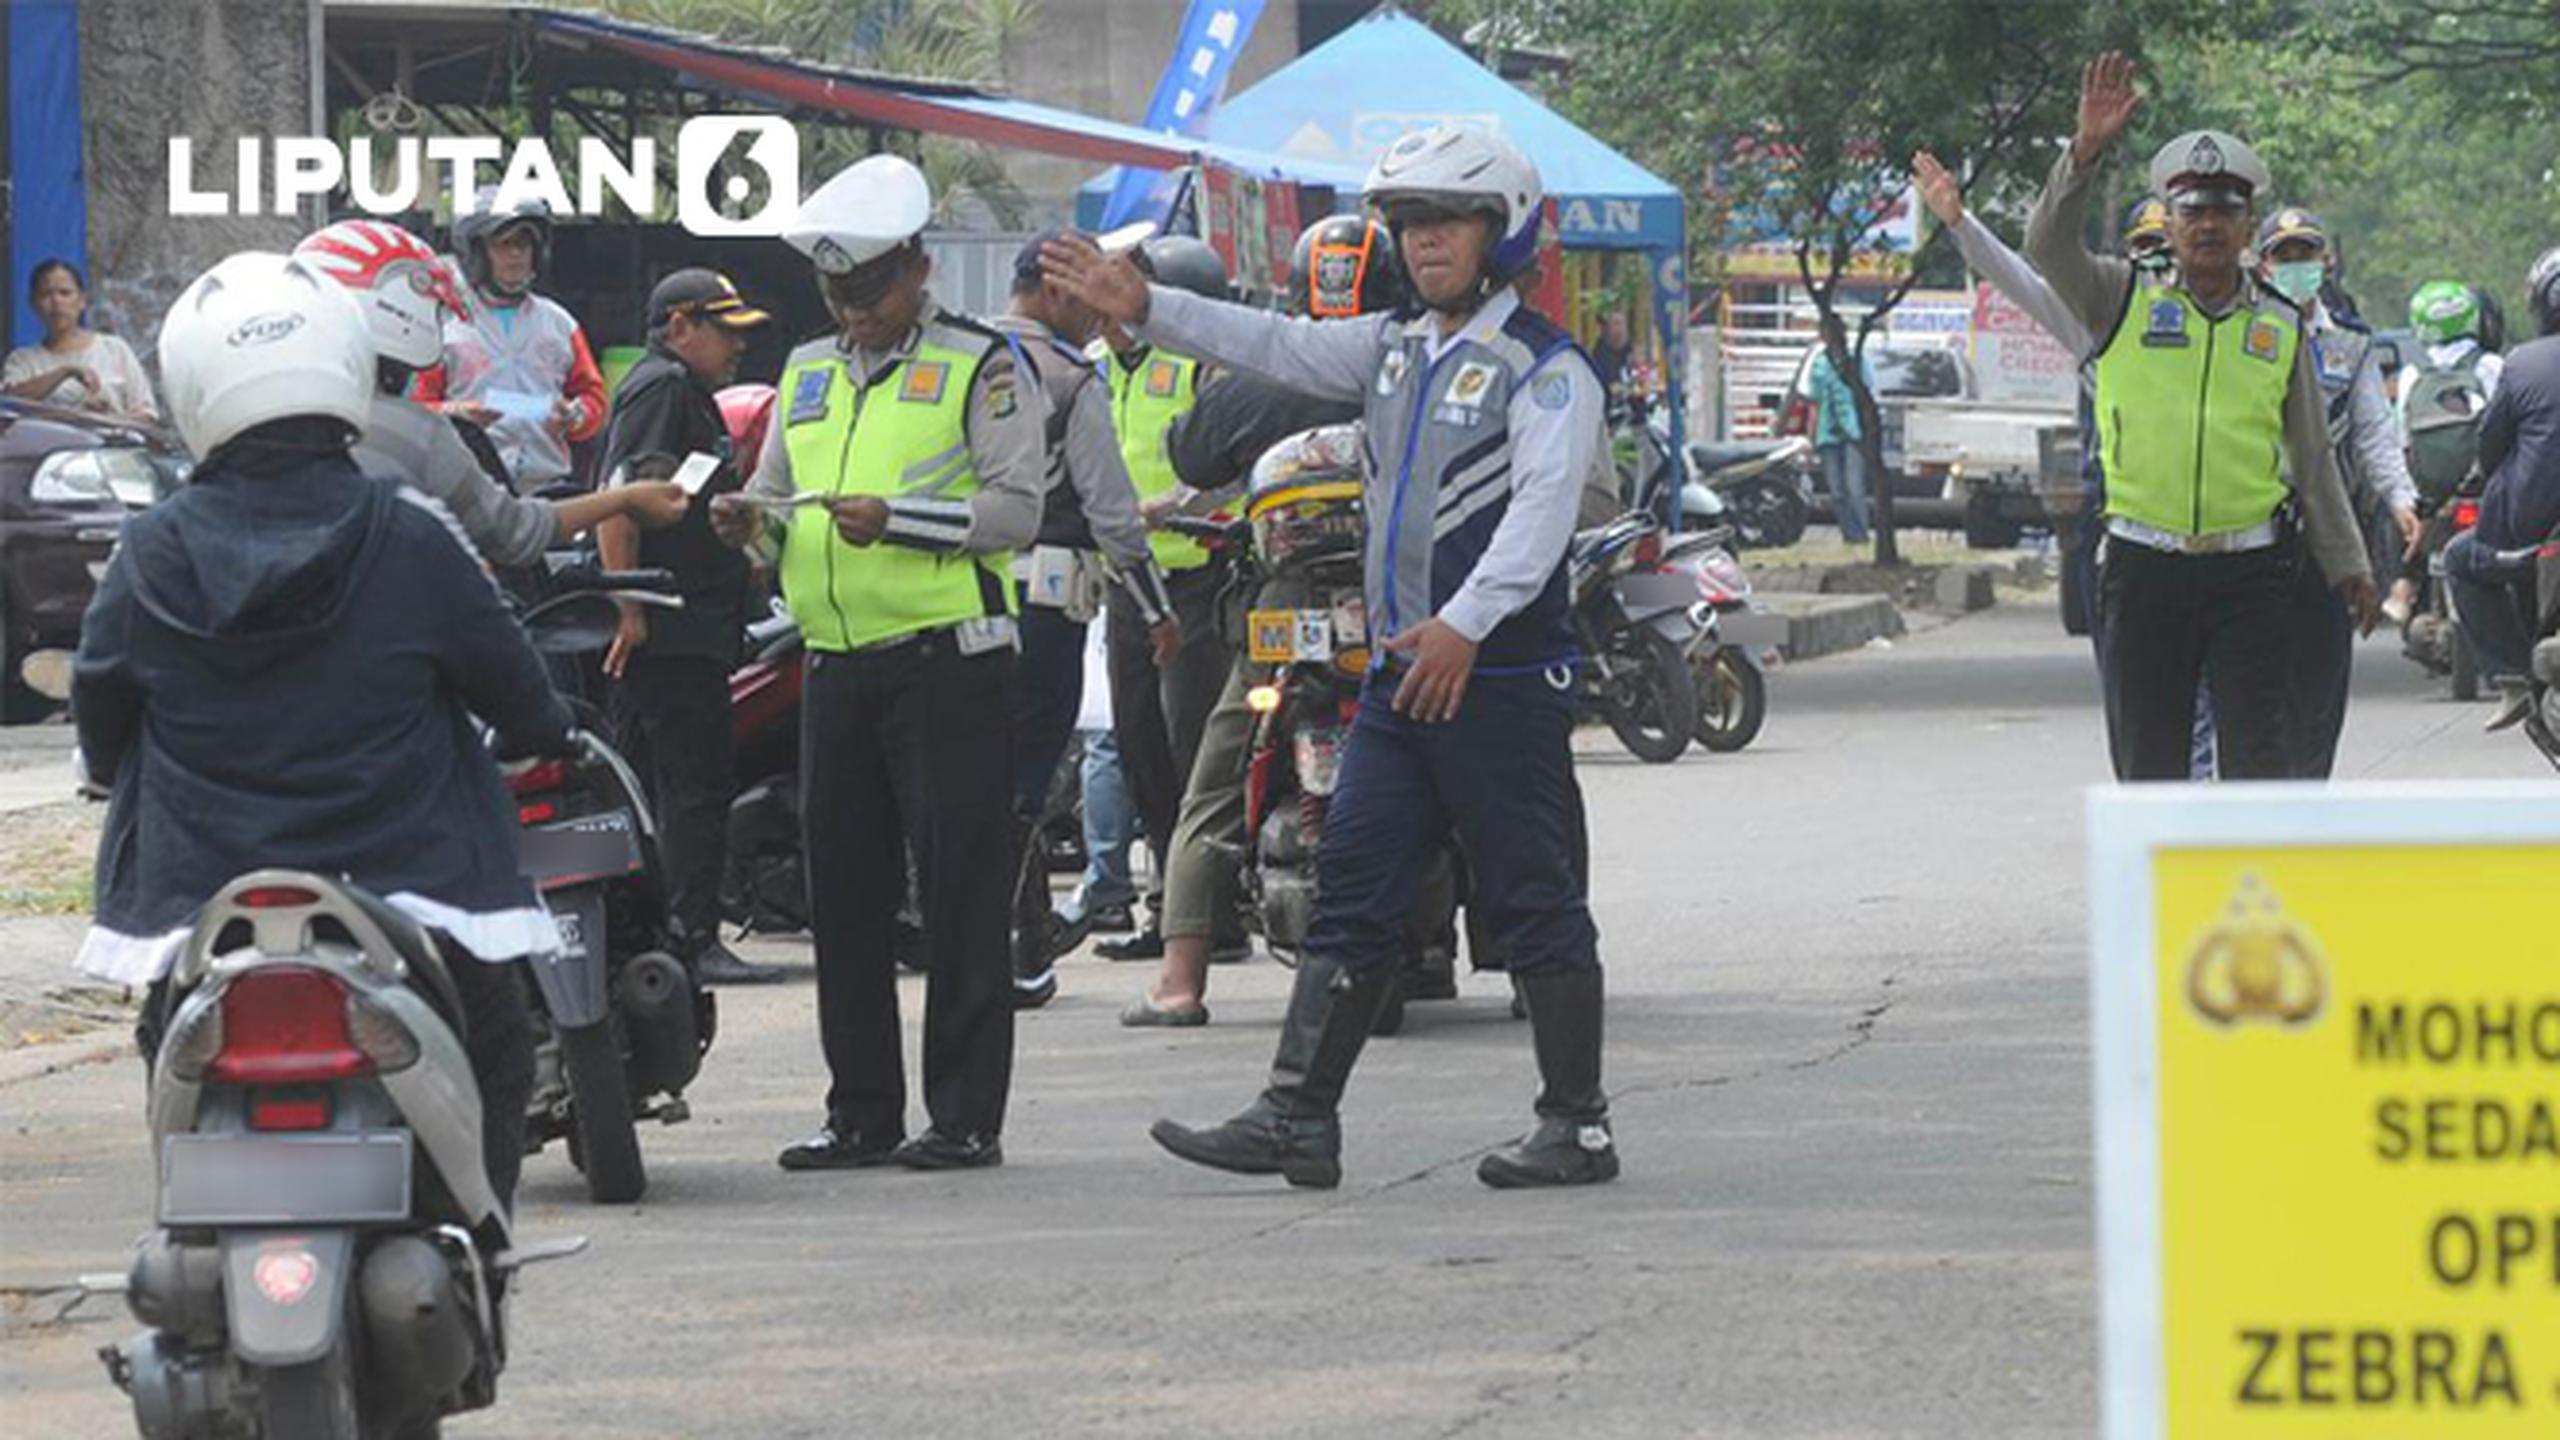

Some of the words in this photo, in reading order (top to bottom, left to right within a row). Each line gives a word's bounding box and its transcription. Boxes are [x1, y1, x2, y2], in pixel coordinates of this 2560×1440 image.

[2376, 1101, 2560, 1159] SEDA
[2430, 1214, 2560, 1286] OP
[2238, 1331, 2518, 1402] ZEBRA
